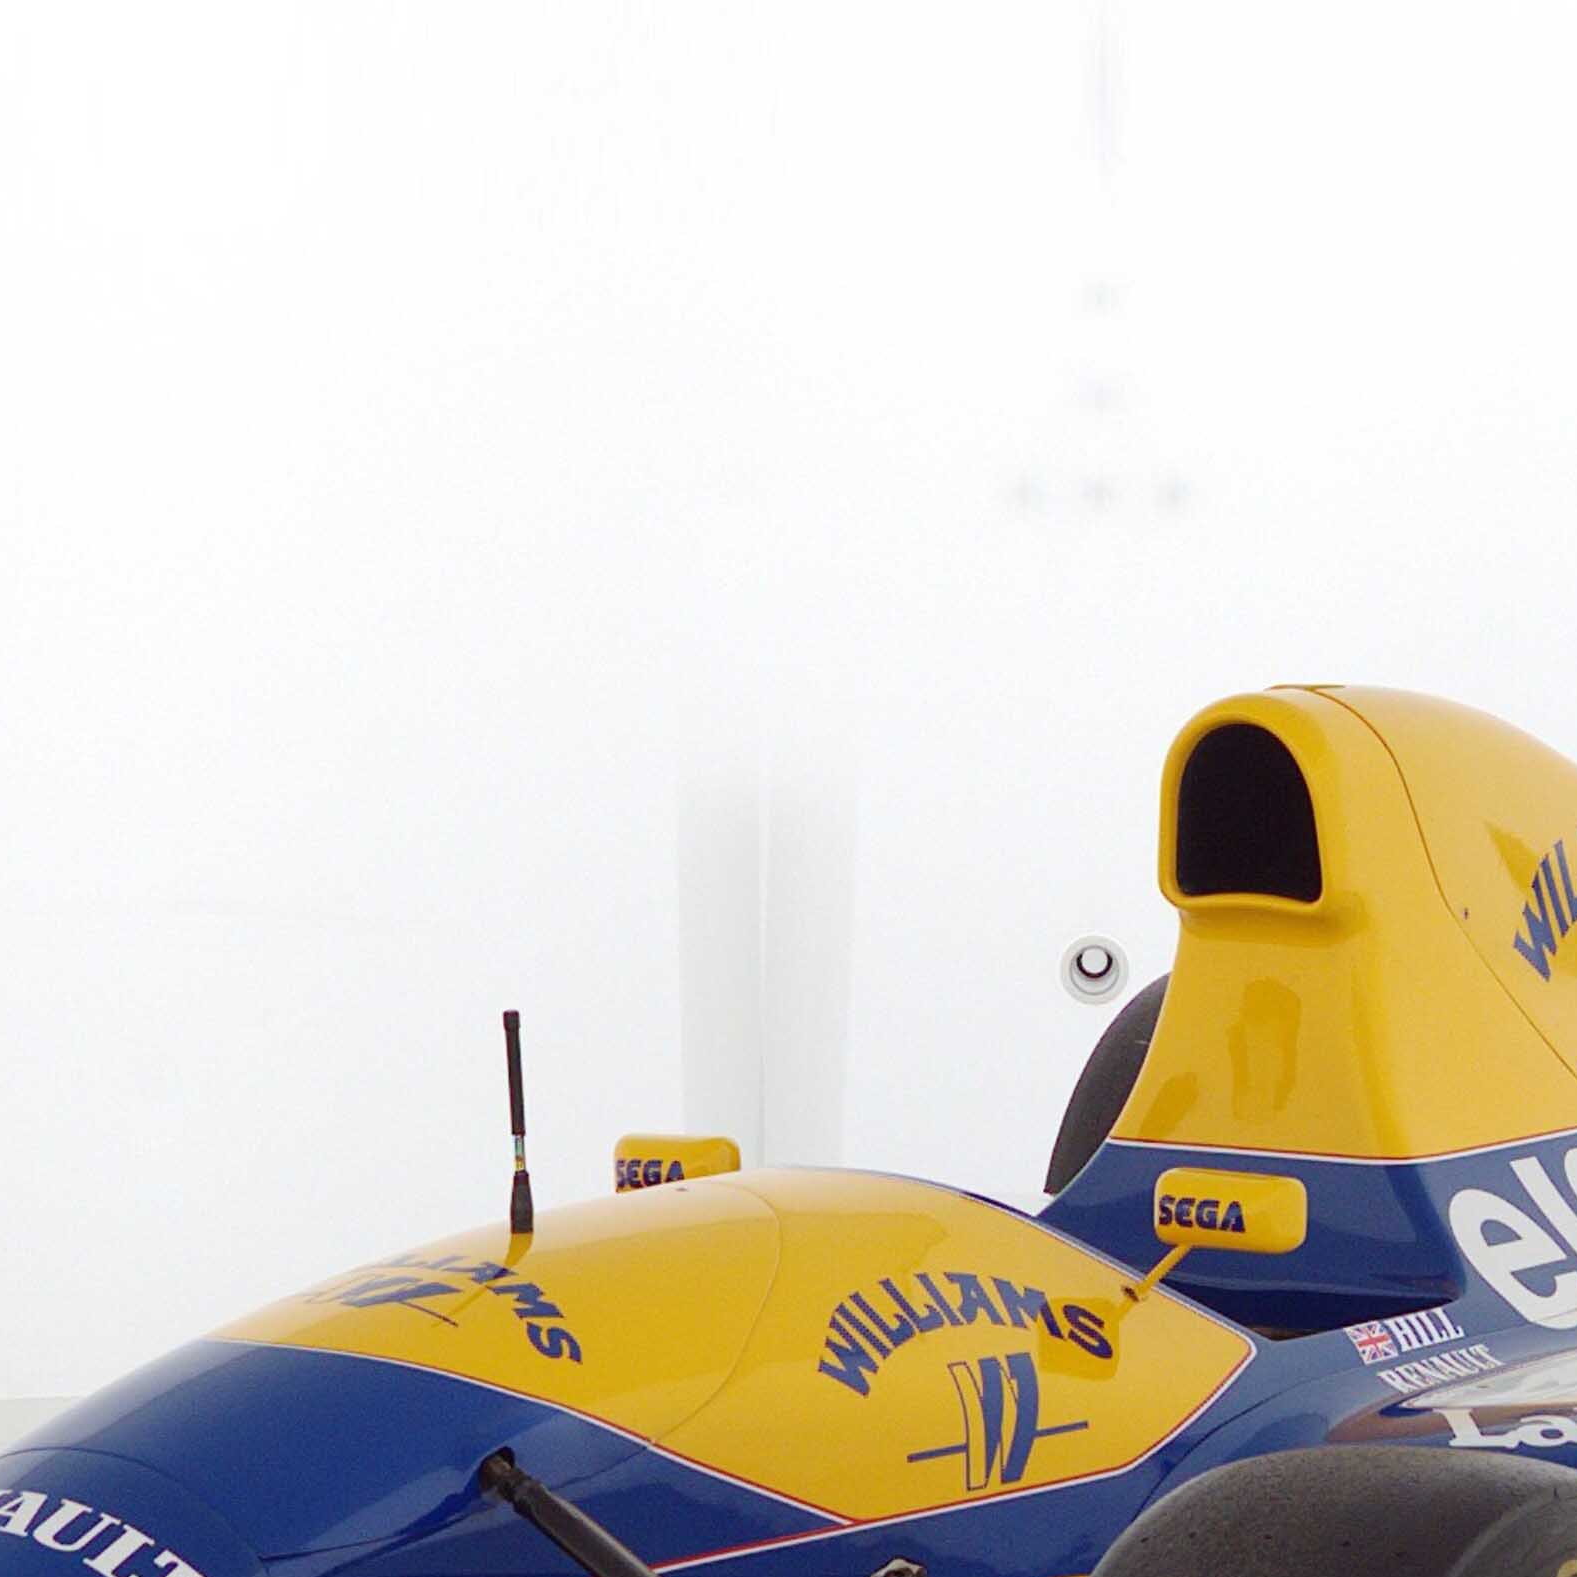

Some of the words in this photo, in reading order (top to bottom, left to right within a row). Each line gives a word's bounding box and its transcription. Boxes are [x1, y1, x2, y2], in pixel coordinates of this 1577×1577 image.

[615, 1159, 685, 1188] SEGA
[1158, 1194, 1246, 1233] SEGA
[818, 1272, 1113, 1399] WILLIAMS
[1383, 1306, 1465, 1352] HILL
[1377, 1343, 1506, 1394] RENAULT
